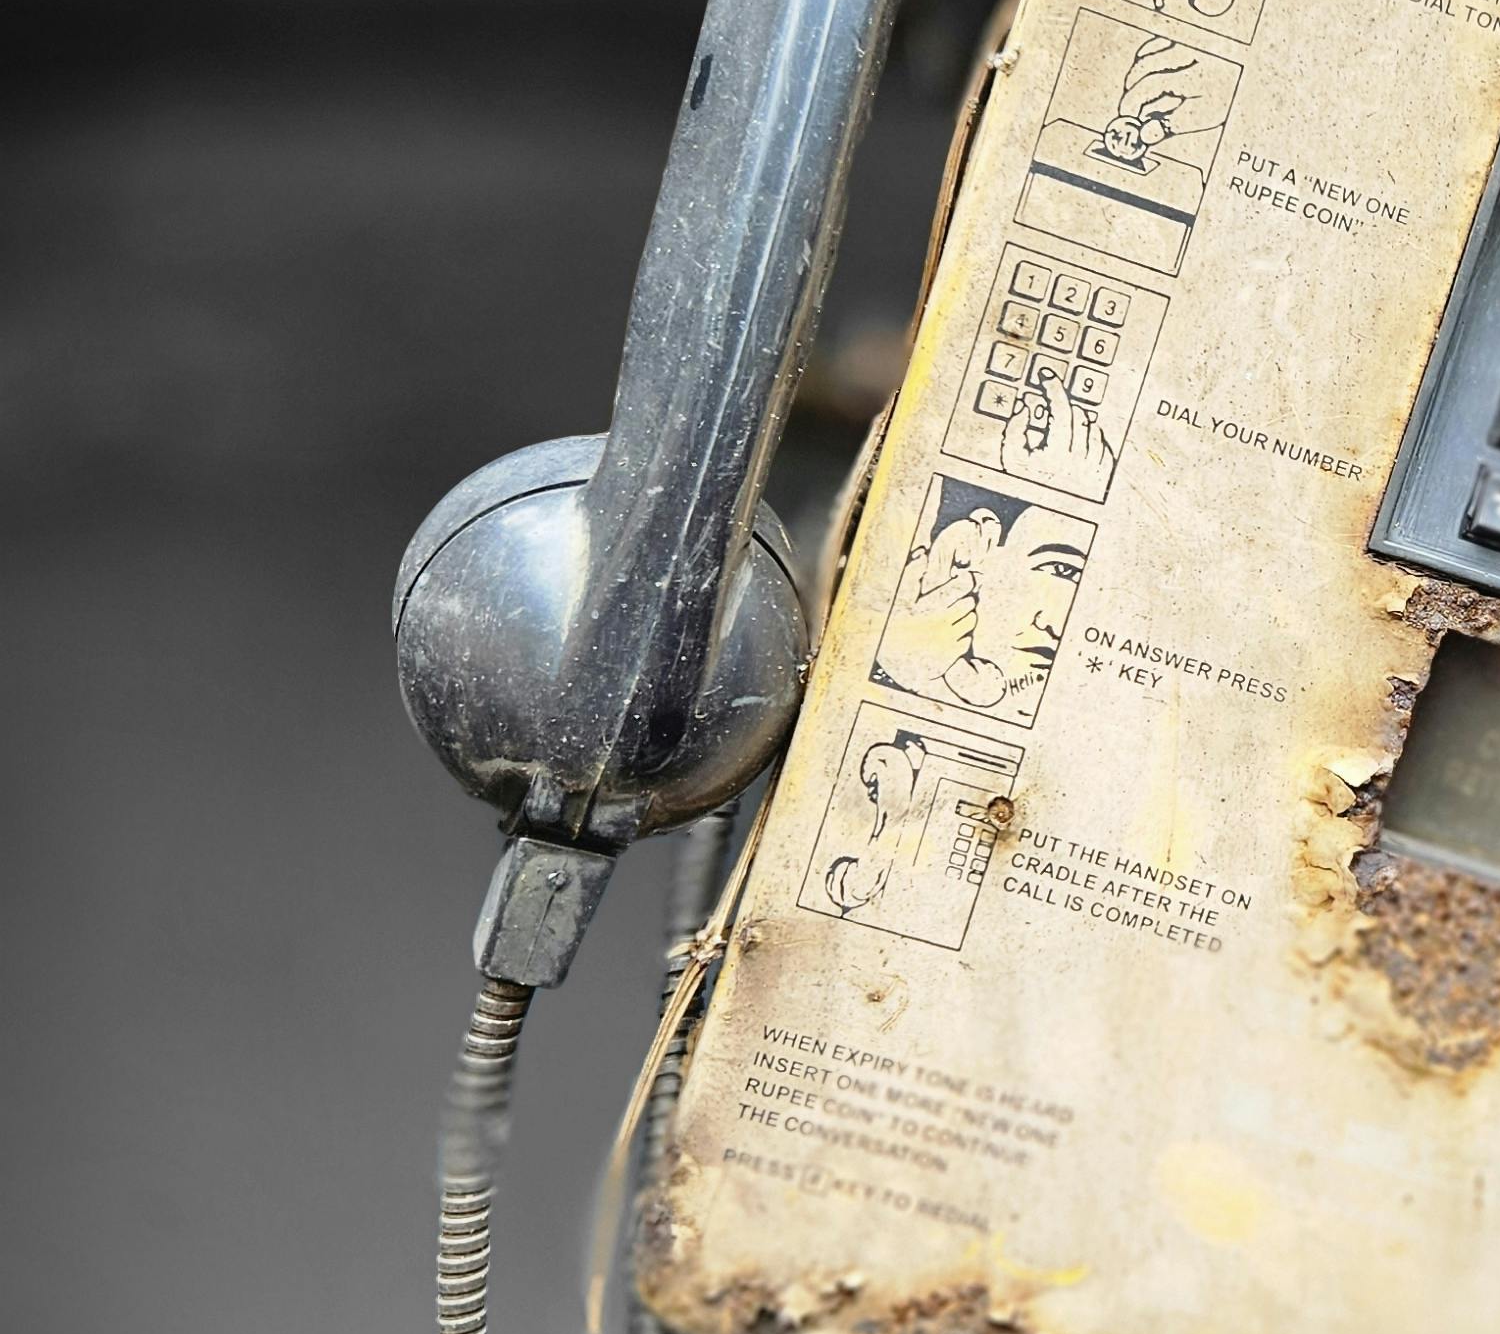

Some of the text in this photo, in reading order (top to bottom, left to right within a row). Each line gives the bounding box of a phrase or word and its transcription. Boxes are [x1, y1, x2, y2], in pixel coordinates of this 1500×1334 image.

[1229, 177, 1298, 213] RUPEE
[1237, 151, 1280, 179] PUT
[1282, 168, 1299, 186] A
[1366, 198, 1411, 225] ONE
[1028, 275, 1117, 316] 1 2 3
[1004, 353, 1094, 393] 7 9
[1054, 326, 1067, 342] 5
[1095, 339, 1106, 355] 6
[1157, 399, 1365, 482] DIAL YOUR NUMBER
[1084, 626, 1289, 704] ON ANSWER PRESS
[1119, 665, 1164, 690] KEY
[1010, 852, 1221, 927] CRADLE AFTER THE
[1017, 828, 1254, 912] PUT THE HANDSET ON
[1003, 877, 1224, 955] CALL IS COMPLETED
[763, 1025, 828, 1057] WHEN
[832, 1045, 909, 1077] EXPIRY
[913, 1067, 971, 1097] TONE
[737, 1102, 778, 1128] THE
[744, 1077, 818, 1109] RUPEE
[888, 1116, 919, 1138] TO
[753, 1051, 832, 1086] INSERT
[836, 1074, 880, 1099] ONE
[885, 1086, 947, 1116] MORE
[1013, 1123, 1059, 1148] ONE
